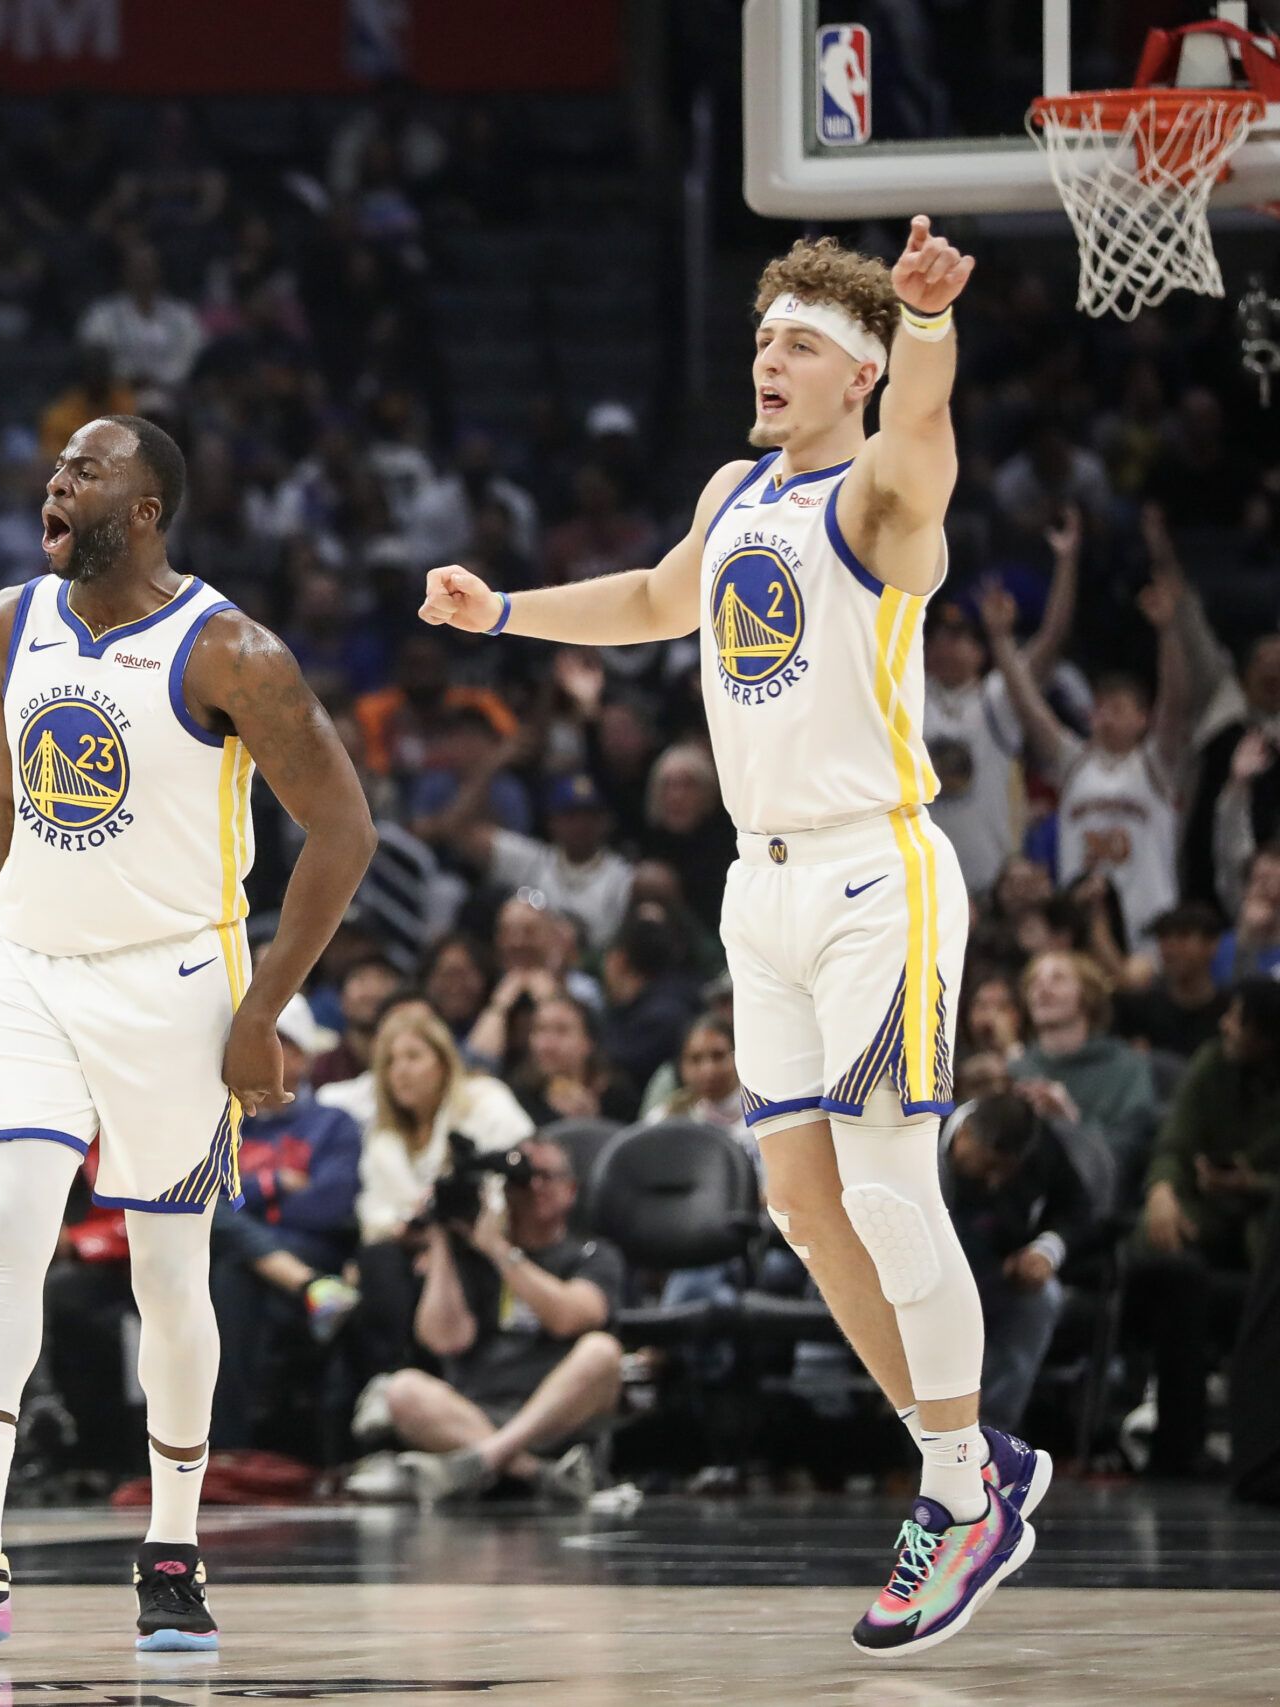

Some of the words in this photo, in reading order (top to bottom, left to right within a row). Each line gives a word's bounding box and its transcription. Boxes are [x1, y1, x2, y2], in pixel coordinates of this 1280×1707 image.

[789, 492, 824, 507] Rakut
[711, 531, 765, 574] GODEN
[770, 534, 804, 573] STATE
[766, 581, 784, 618] 2
[114, 652, 161, 670] Rakuten
[20, 684, 85, 720] GOLDEN
[91, 690, 131, 733] STATE
[76, 734, 115, 773] 23
[18, 796, 135, 852] WARRIORS
[768, 844, 785, 861] W
